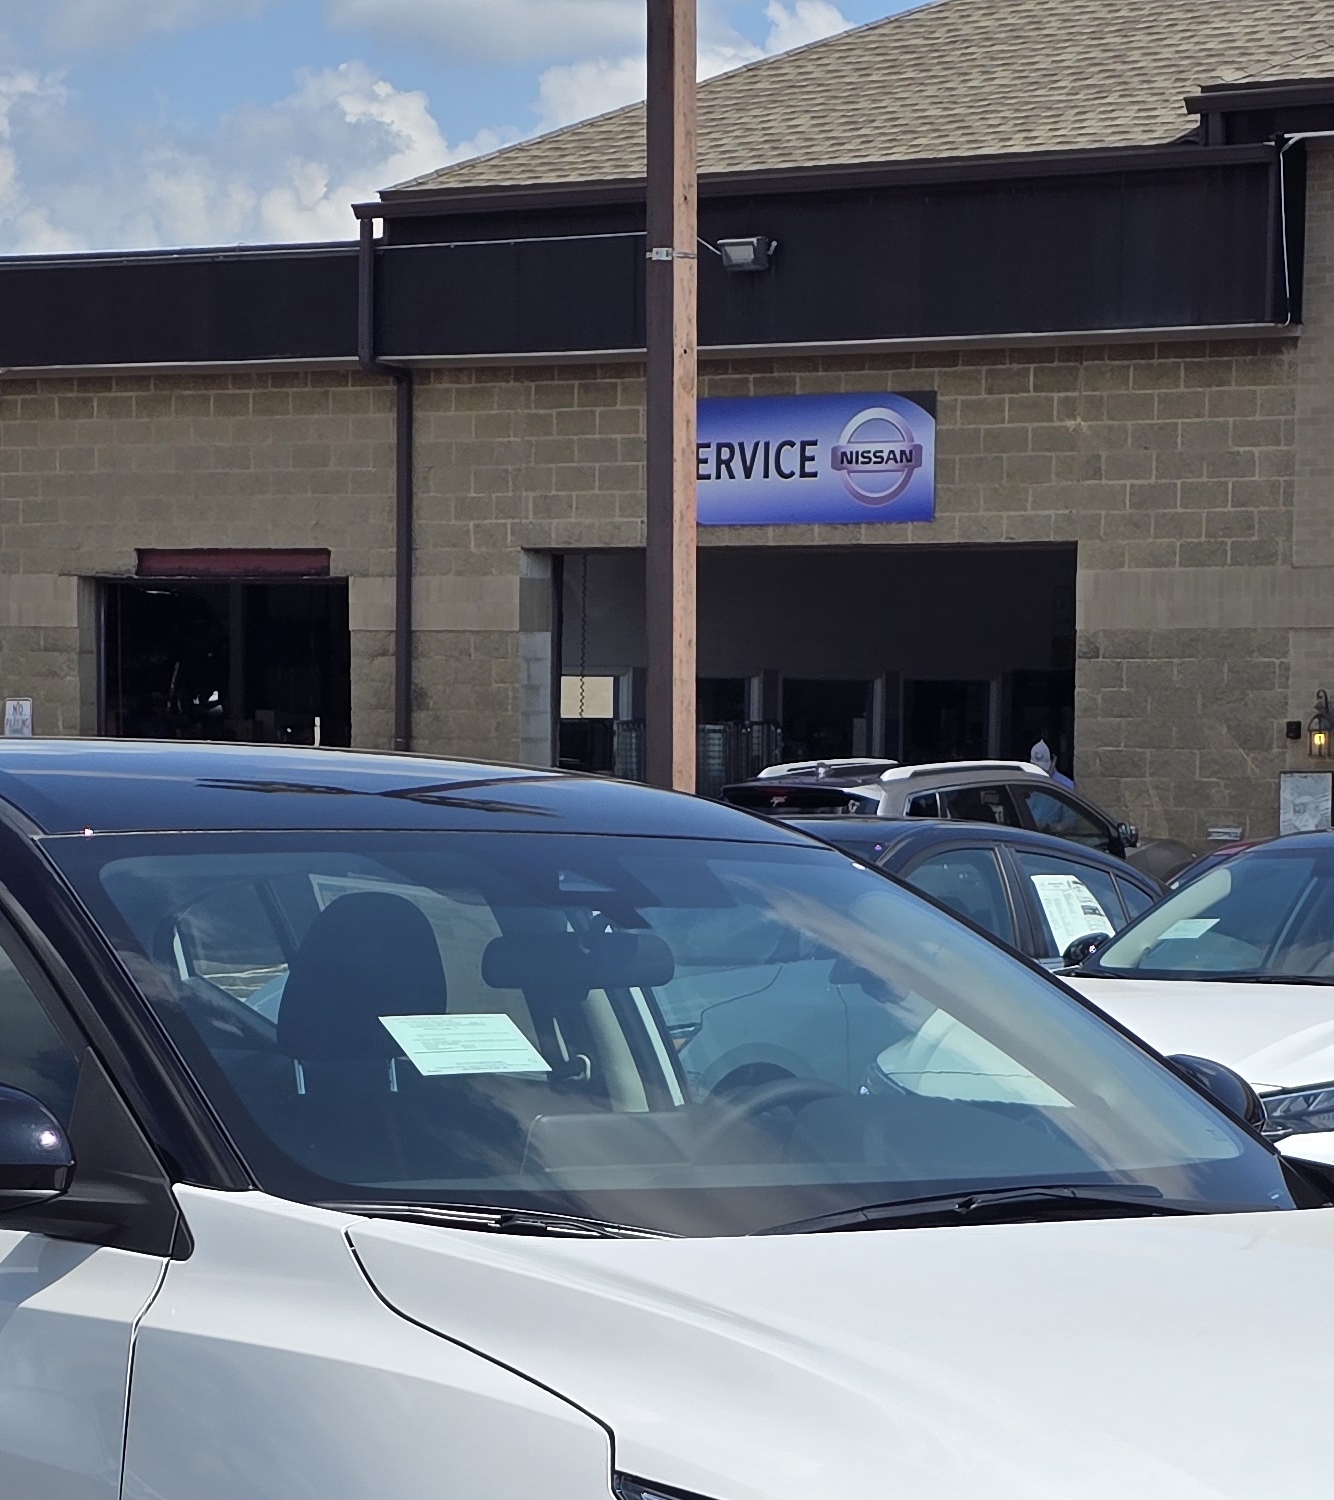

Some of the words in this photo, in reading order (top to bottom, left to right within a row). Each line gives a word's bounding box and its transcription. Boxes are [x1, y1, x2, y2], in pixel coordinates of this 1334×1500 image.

[696, 438, 819, 481] ERVICE
[839, 449, 914, 466] NISSAN
[12, 702, 24, 717] NO
